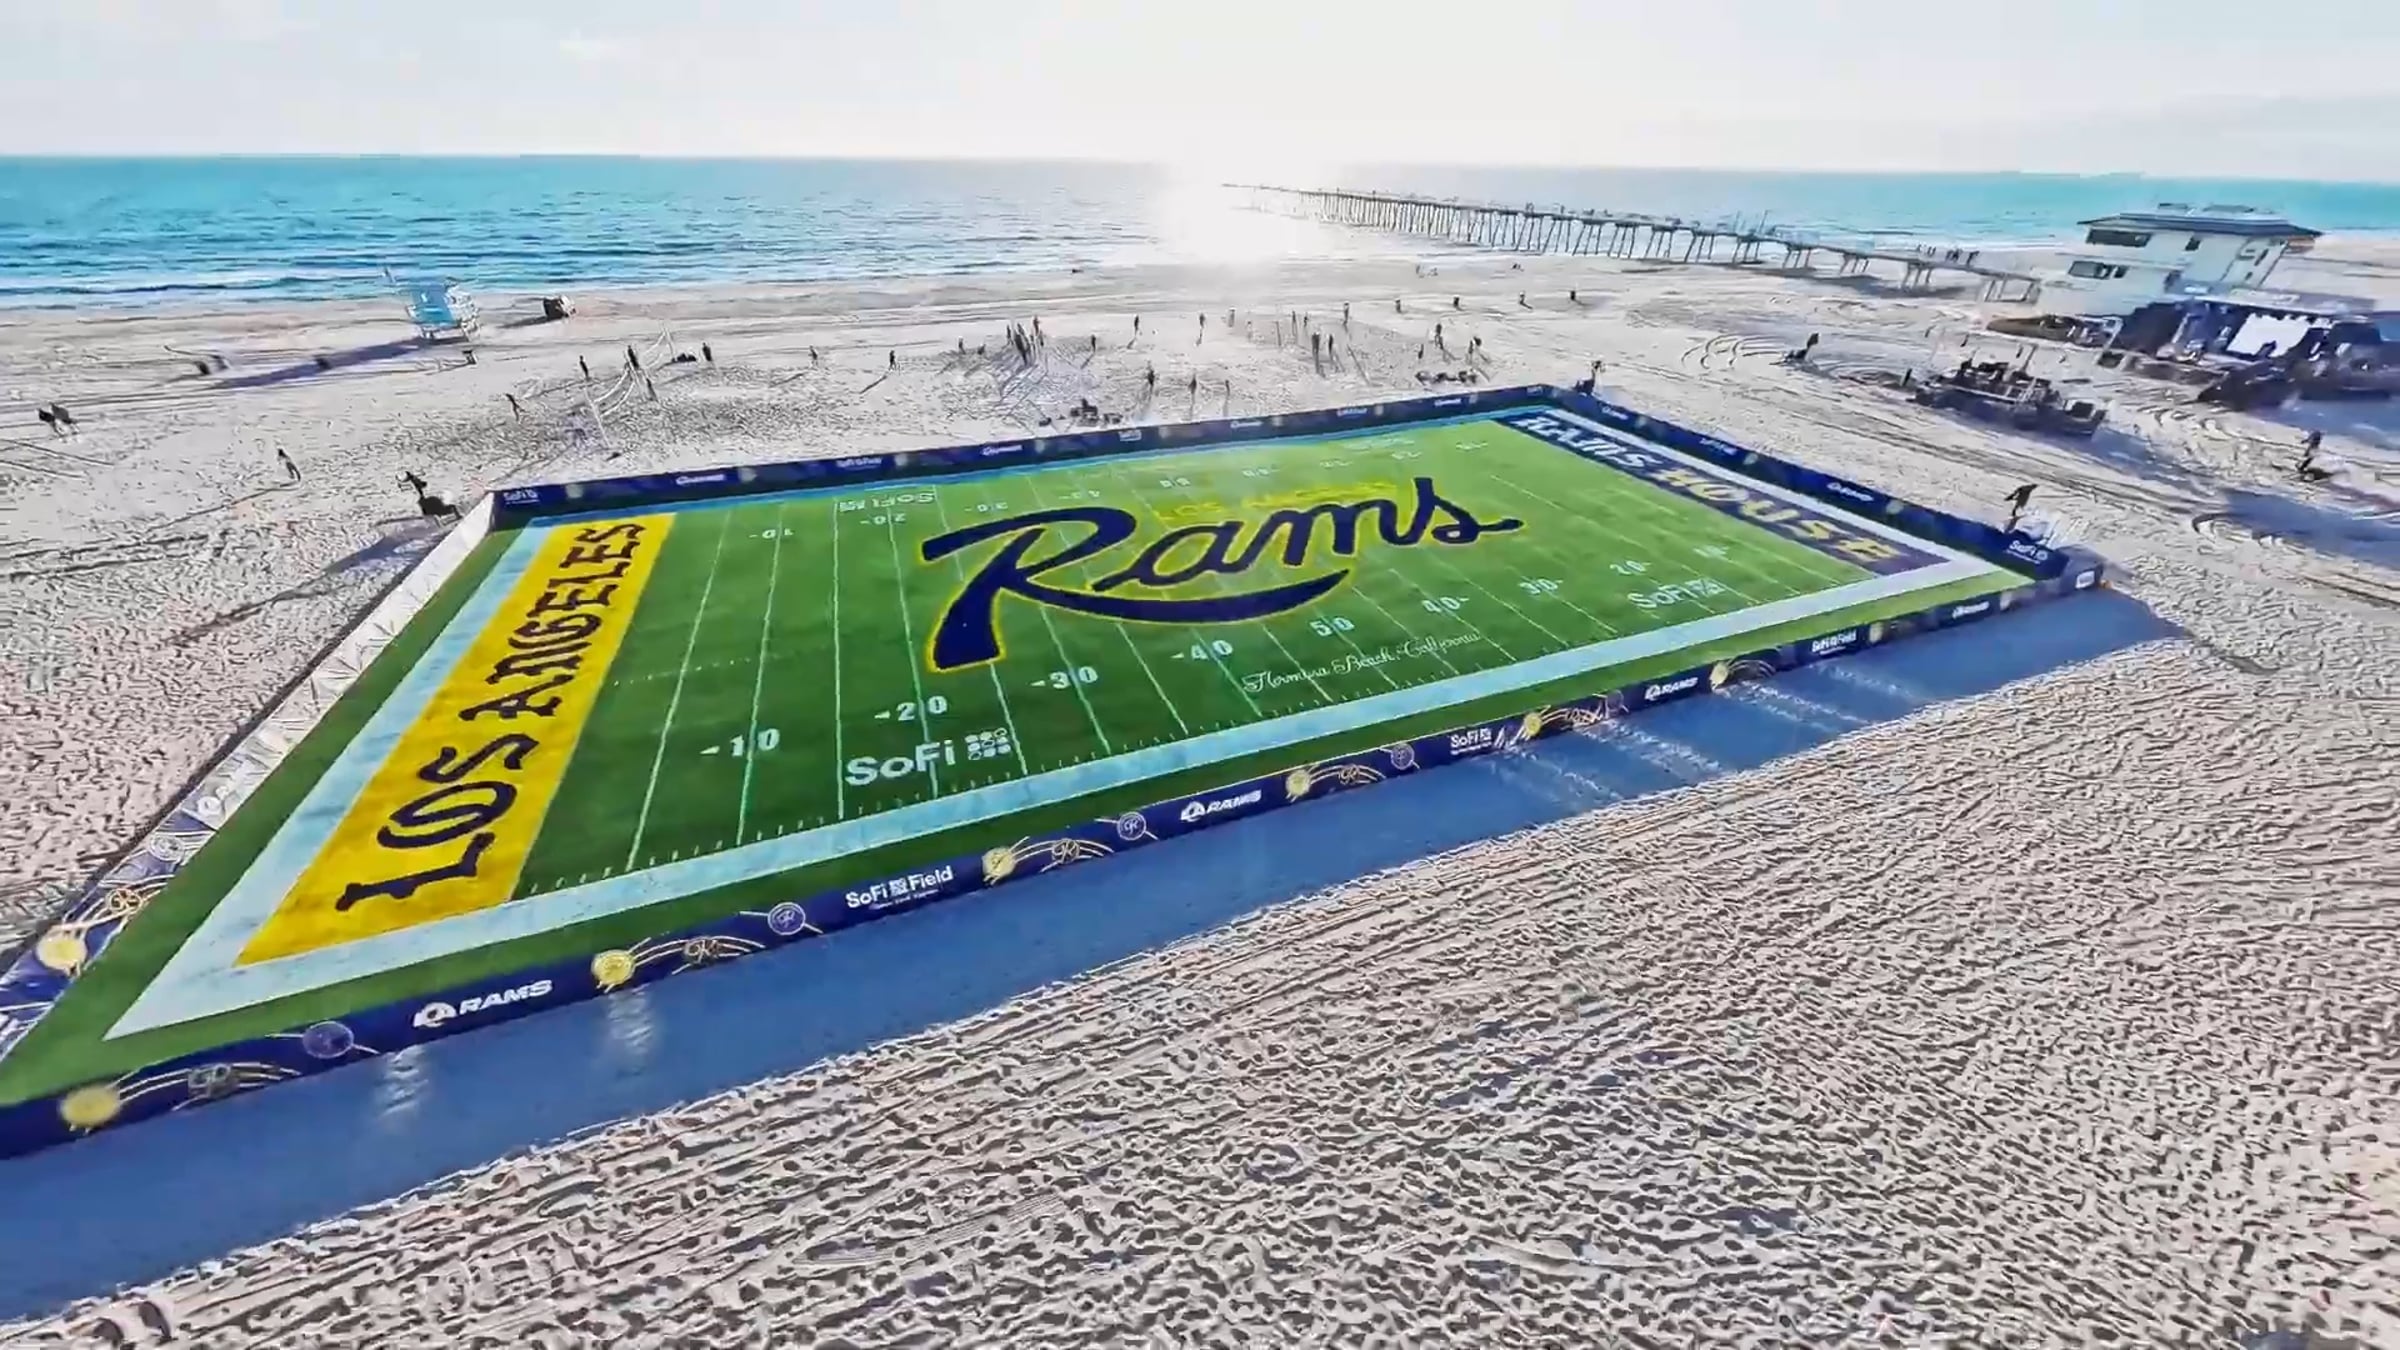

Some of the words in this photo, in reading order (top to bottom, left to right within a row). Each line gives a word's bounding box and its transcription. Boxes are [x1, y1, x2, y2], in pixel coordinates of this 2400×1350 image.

[920, 477, 1524, 671] Rams
[1421, 596, 1461, 614] 40
[1309, 616, 1356, 637] 50
[1191, 639, 1234, 661] 40
[1049, 665, 1099, 690] 30
[1660, 676, 1699, 696] RAMS
[334, 733, 541, 912] LOS
[458, 522, 647, 722] ANGELES
[897, 695, 949, 722] 20
[729, 727, 781, 758] 10
[1450, 729, 1480, 749] SoFi
[844, 738, 957, 786] SoFi
[1206, 789, 1263, 814] RAMS
[844, 882, 889, 909] SoFi
[906, 864, 955, 892] Field
[458, 978, 554, 1015] RAMS
